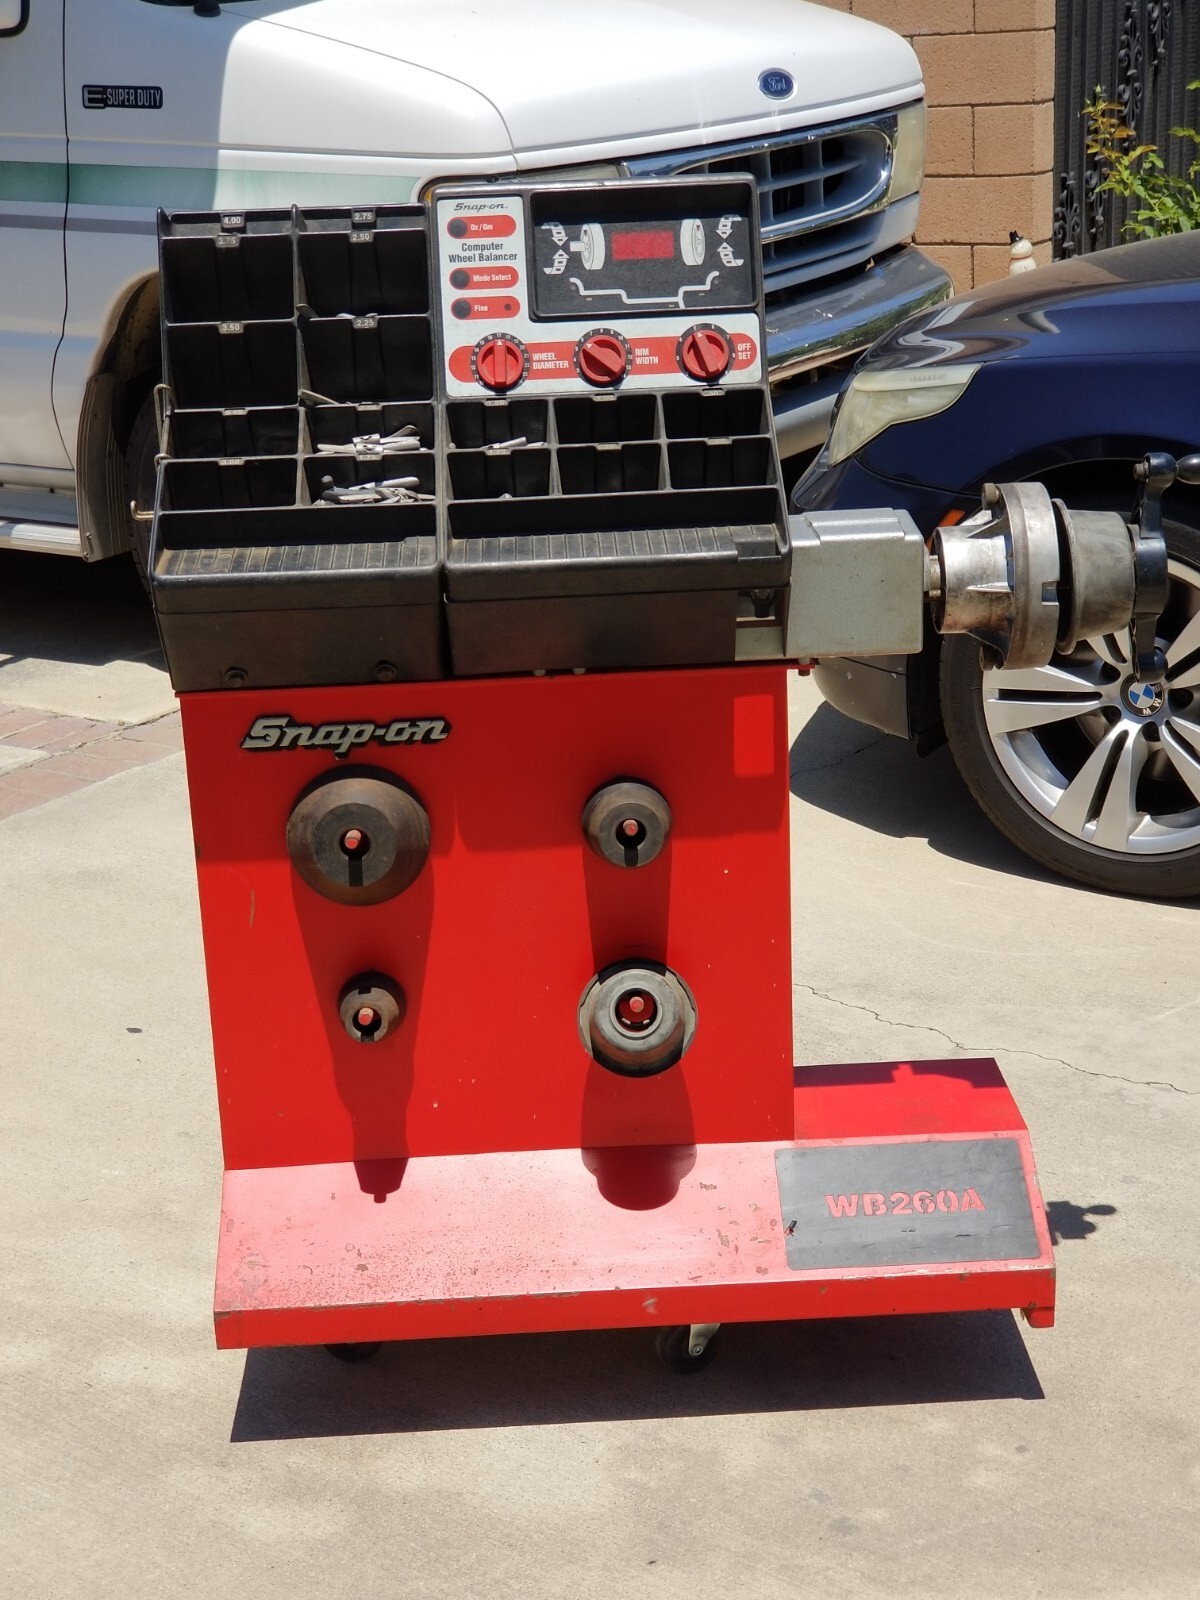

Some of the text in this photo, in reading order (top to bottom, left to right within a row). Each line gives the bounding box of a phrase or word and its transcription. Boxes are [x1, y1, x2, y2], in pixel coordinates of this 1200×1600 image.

[767, 76, 787, 91] Ford
[138, 89, 160, 106] DUTY
[453, 202, 507, 213] Snap-on
[222, 216, 242, 225] 4.00
[353, 212, 373, 221] 2.75
[351, 232, 371, 241] 2.50
[217, 237, 237, 246] 3.75
[462, 242, 503, 251] Computer
[448, 253, 518, 262] Wheel Balancer
[222, 323, 240, 331] 3.50
[356, 318, 374, 327] 2.25
[533, 361, 569, 369] DIAMETER
[241, 716, 448, 755] Snap-on
[825, 1187, 986, 1218] WB260A
